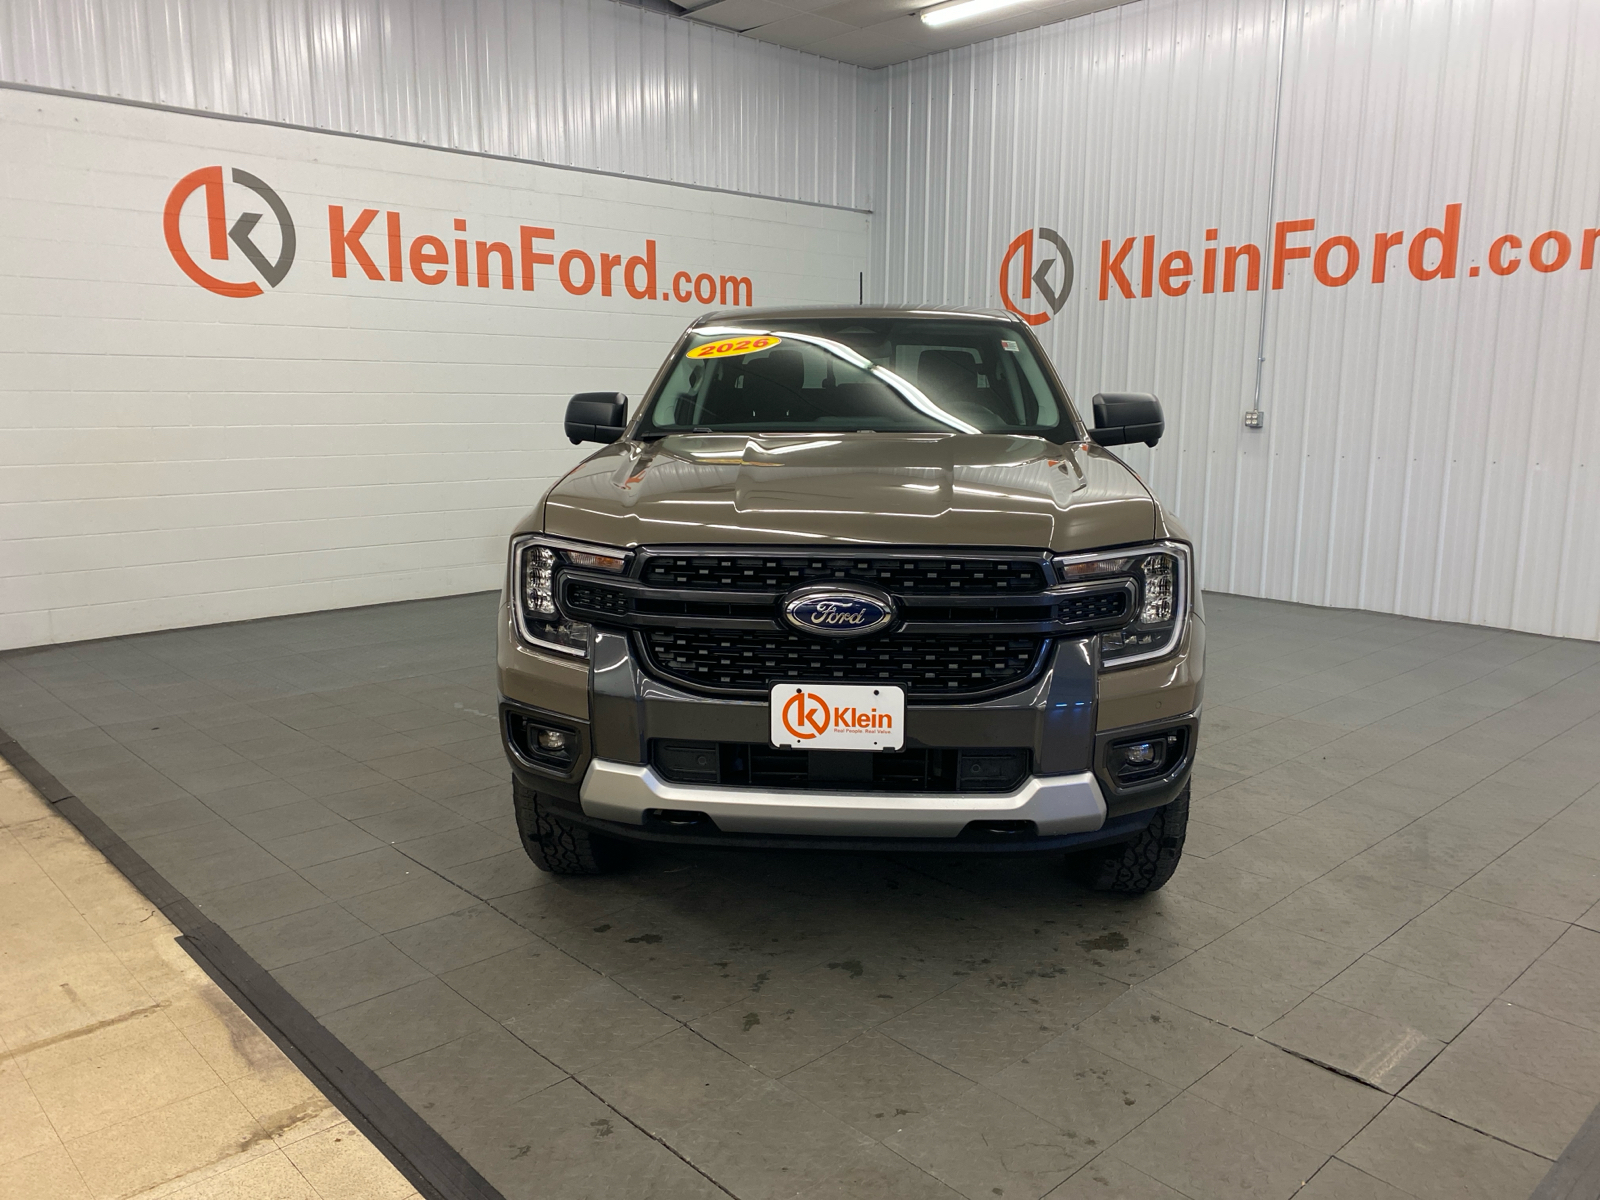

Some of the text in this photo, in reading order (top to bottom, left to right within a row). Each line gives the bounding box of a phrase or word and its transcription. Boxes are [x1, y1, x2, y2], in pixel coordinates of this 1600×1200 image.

[328, 205, 753, 307] KleinFord.com
[698, 338, 769, 357] 2026
[811, 601, 867, 624] Ford
[833, 707, 893, 729] Klein
